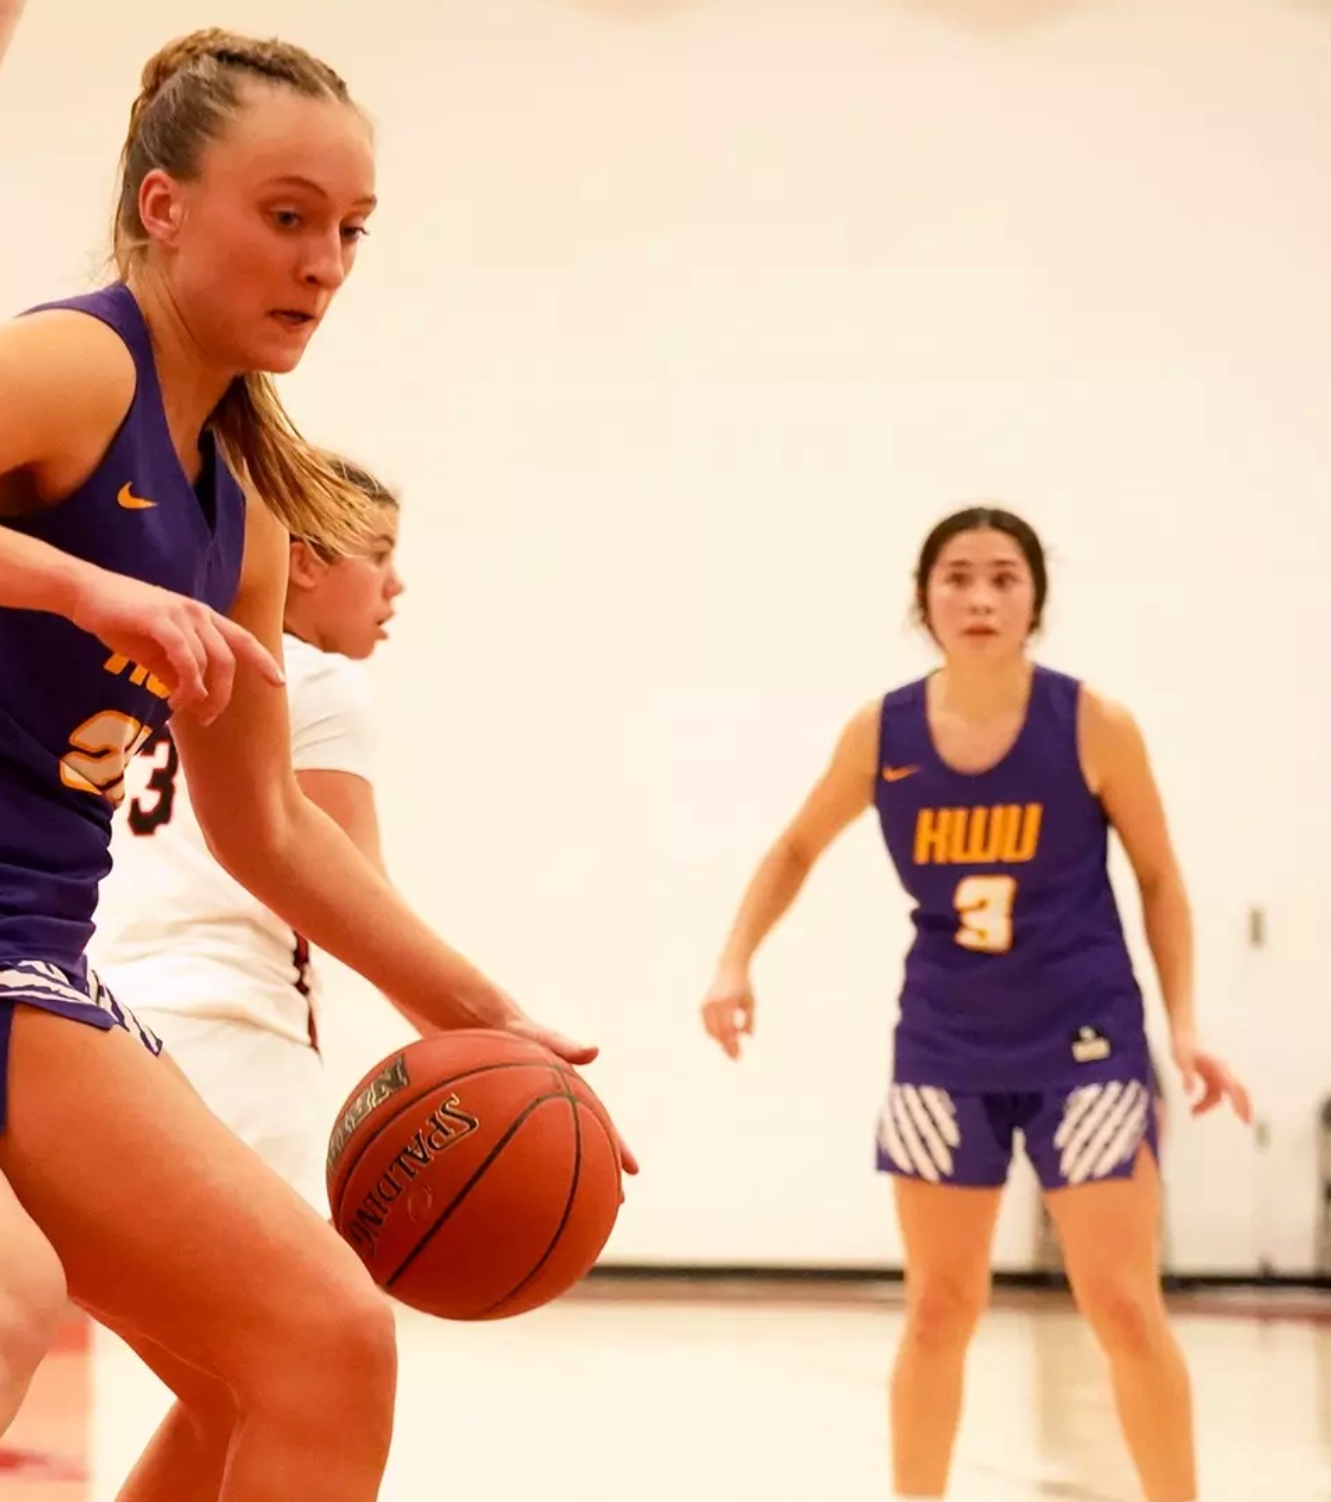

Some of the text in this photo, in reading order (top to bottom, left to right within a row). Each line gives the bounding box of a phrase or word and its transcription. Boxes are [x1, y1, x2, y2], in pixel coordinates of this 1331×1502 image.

[59, 708, 153, 812] 2
[913, 802, 1044, 866] KWU
[952, 872, 1018, 955] 3
[345, 1091, 481, 1258] SPALDING
